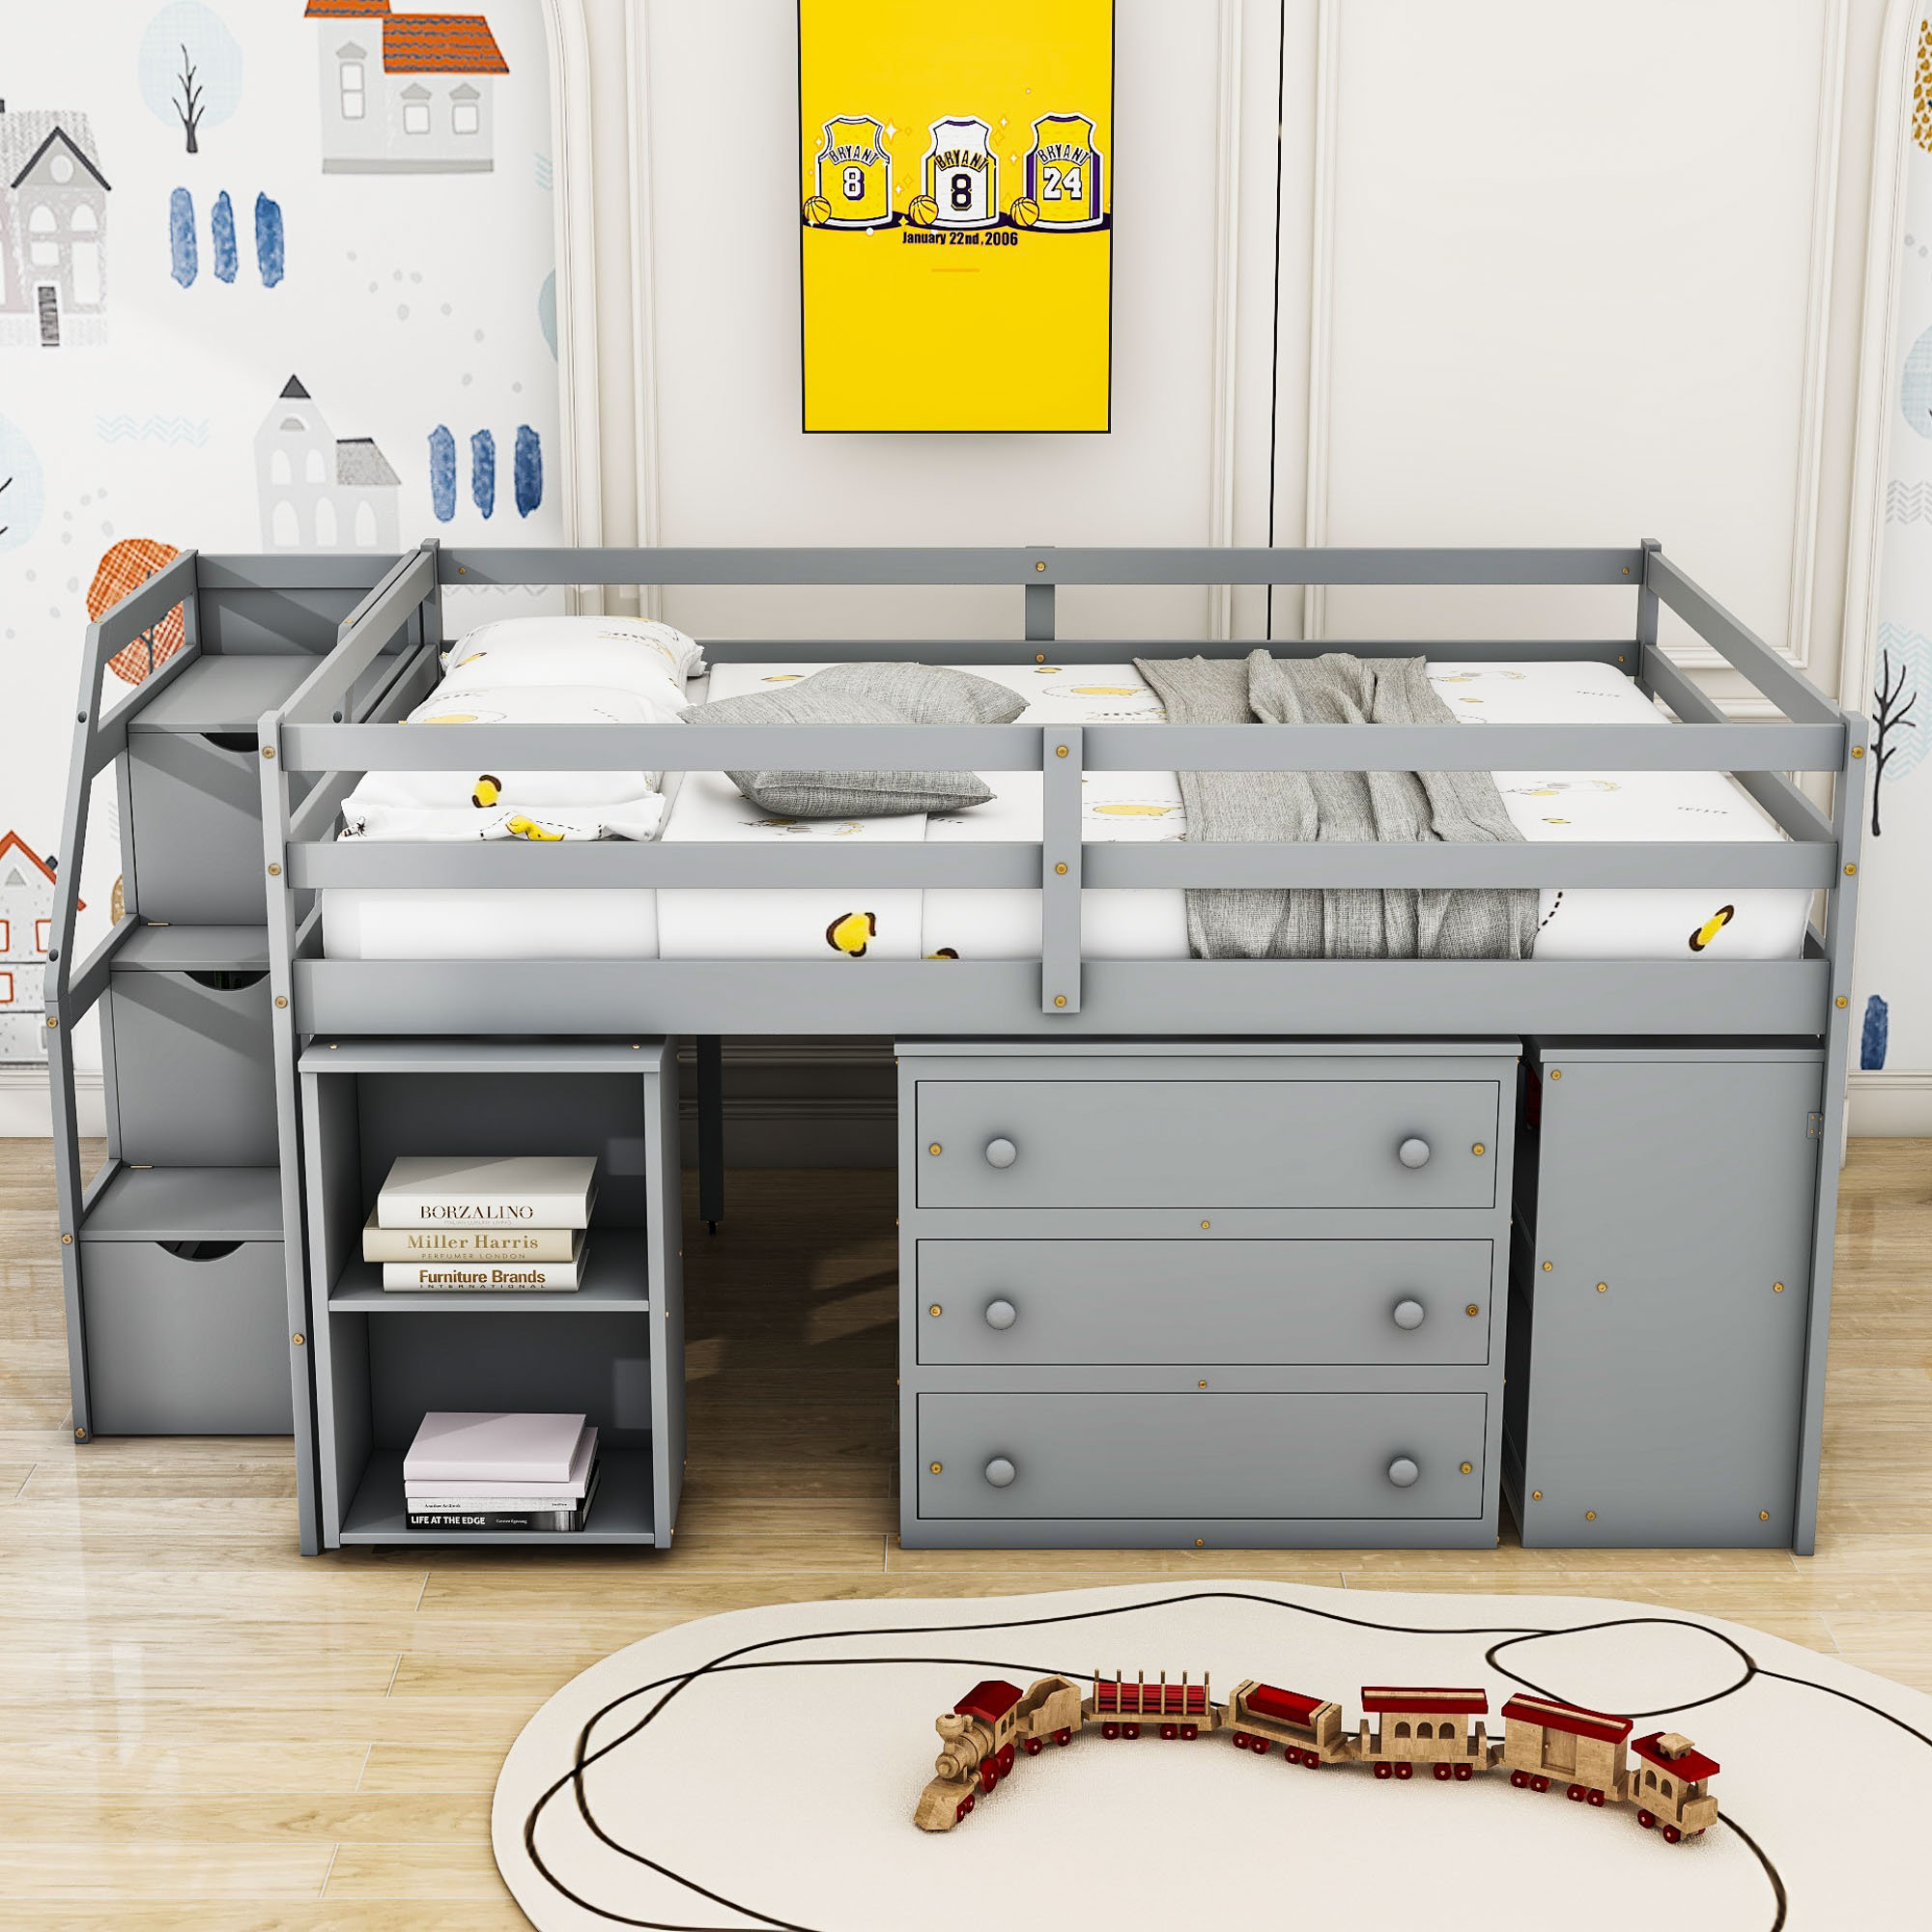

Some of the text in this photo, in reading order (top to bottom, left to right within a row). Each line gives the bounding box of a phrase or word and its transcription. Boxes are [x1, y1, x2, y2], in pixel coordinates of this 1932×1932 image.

[829, 145, 879, 165] BRYANT
[934, 150, 989, 172] BRYANT
[1037, 145, 1092, 165] BRYANT
[842, 166, 865, 201] 8
[950, 173, 973, 211] 8
[1042, 167, 1083, 201] 24
[902, 232, 947, 245] January
[420, 1206, 533, 1219] BORZALINO
[407, 1235, 539, 1249] Miller Harris
[419, 1269, 546, 1283] Furniture Brands
[411, 1516, 429, 1524] LIFE
[431, 1516, 441, 1524] AT
[462, 1517, 486, 1525] EDGE
